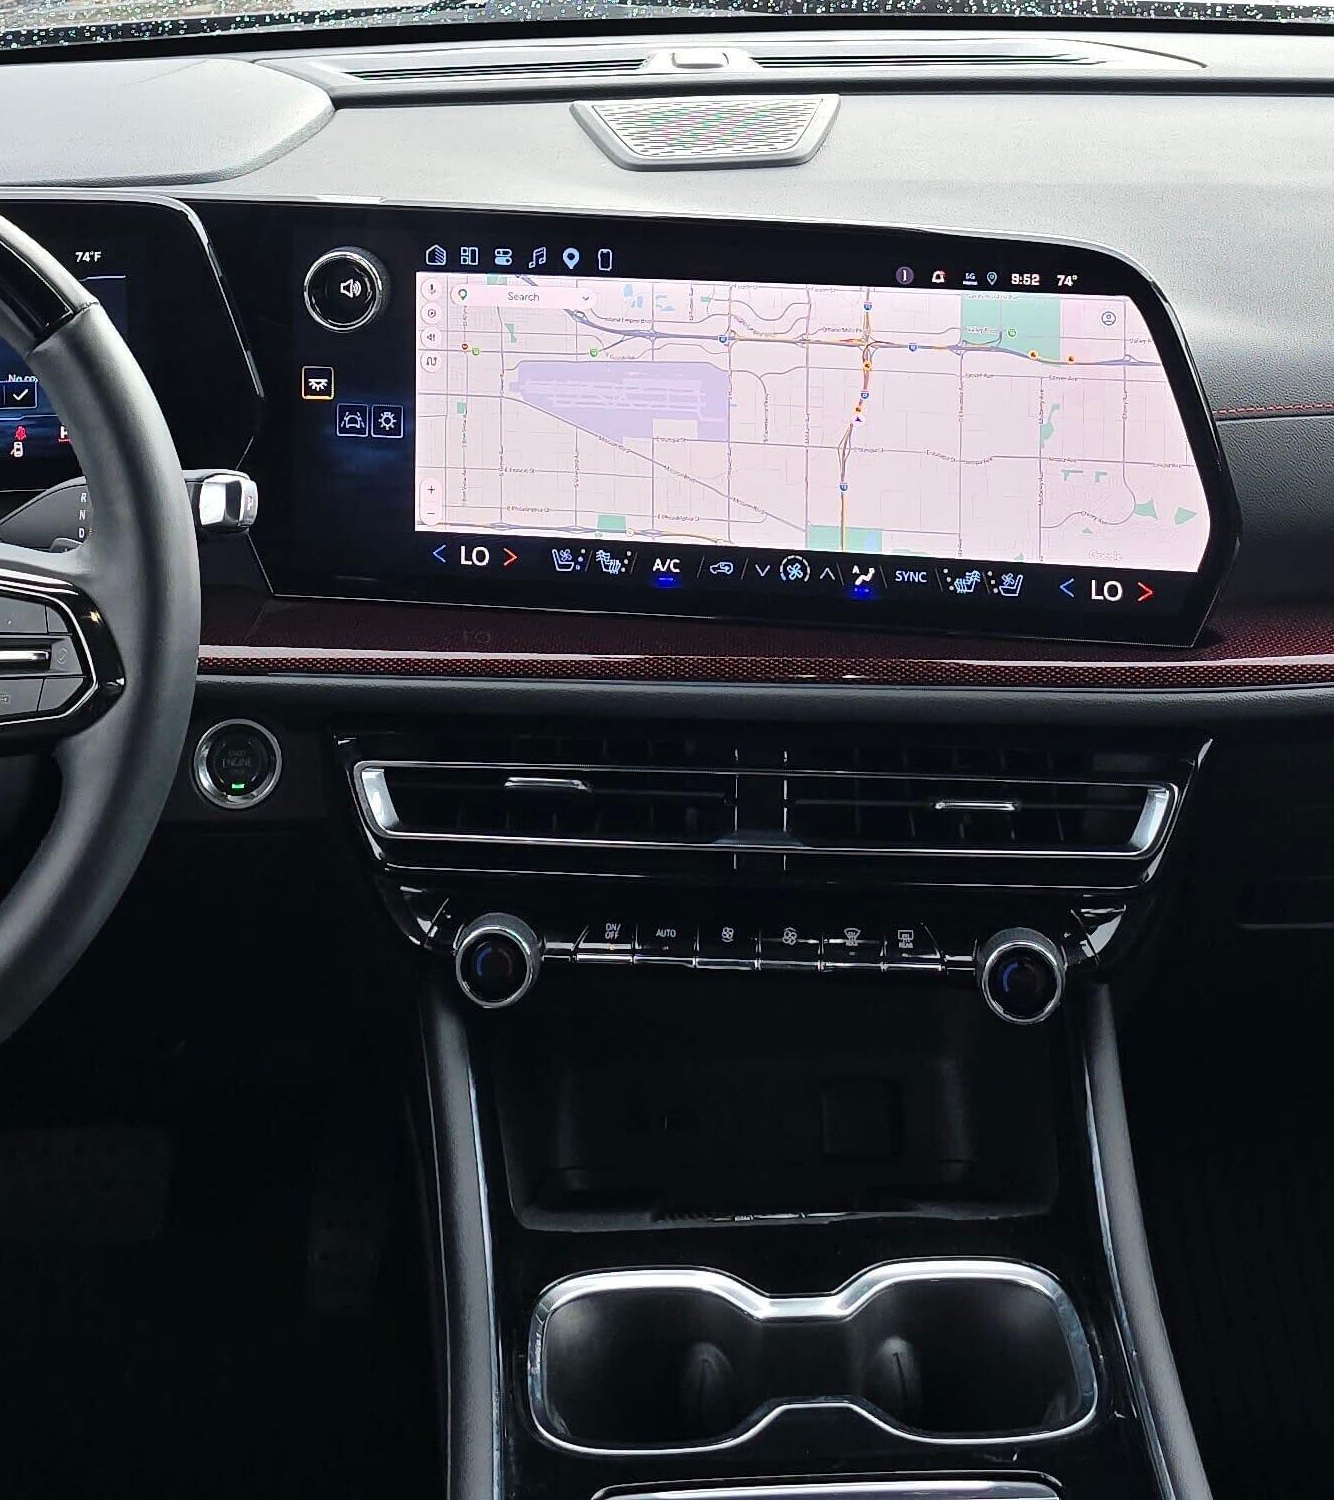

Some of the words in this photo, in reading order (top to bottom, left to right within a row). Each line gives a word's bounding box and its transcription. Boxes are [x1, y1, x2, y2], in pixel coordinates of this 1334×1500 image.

[75, 251, 102, 262] 74°F
[1011, 273, 1040, 286] 9:52
[508, 291, 540, 302] Search
[80, 493, 87, 502] R
[79, 510, 86, 520] N
[78, 528, 85, 538] D
[460, 545, 490, 566] LO
[652, 558, 681, 573] A/C
[895, 570, 927, 583] SYNC
[1091, 579, 1123, 602] LO
[604, 931, 620, 940] OFF
[656, 929, 677, 938] AUTO
